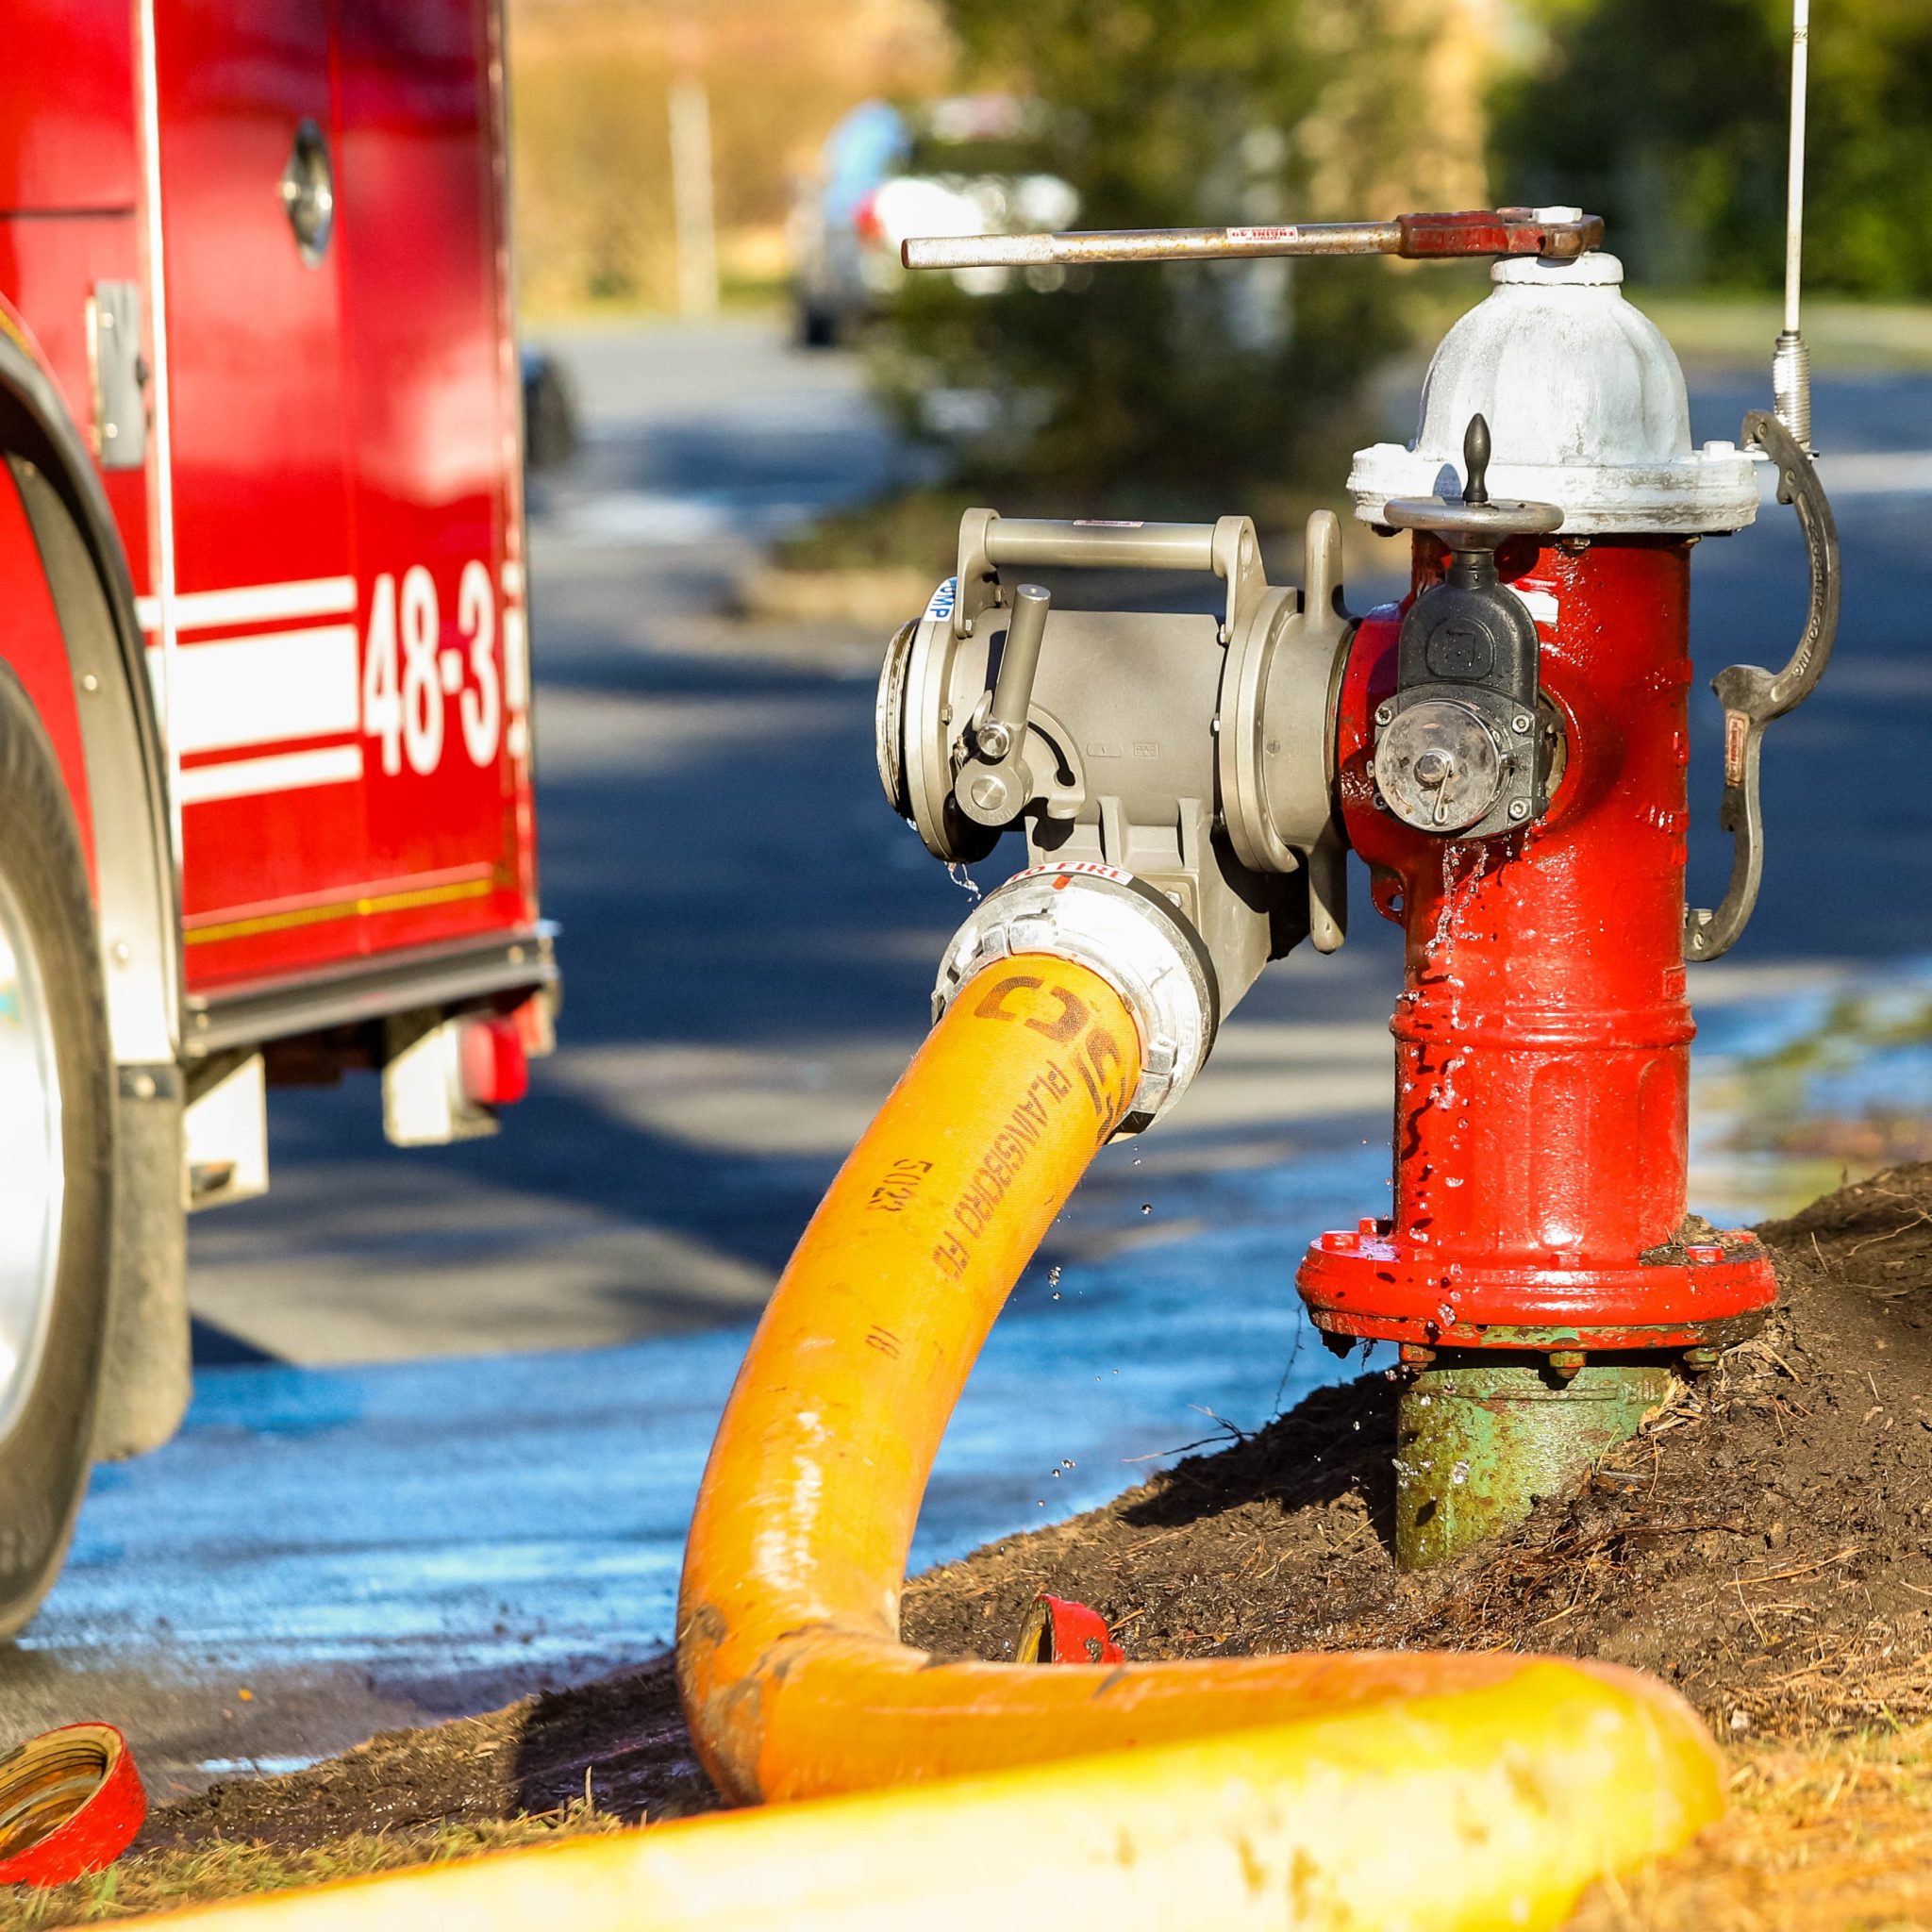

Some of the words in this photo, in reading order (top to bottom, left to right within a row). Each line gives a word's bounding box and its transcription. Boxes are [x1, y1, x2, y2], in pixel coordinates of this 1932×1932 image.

[930, 577, 957, 618] UMP
[362, 558, 501, 777] 48-3
[1056, 862, 1131, 884] FIRE
[954, 1058, 1073, 1240] PLAINSBORO
